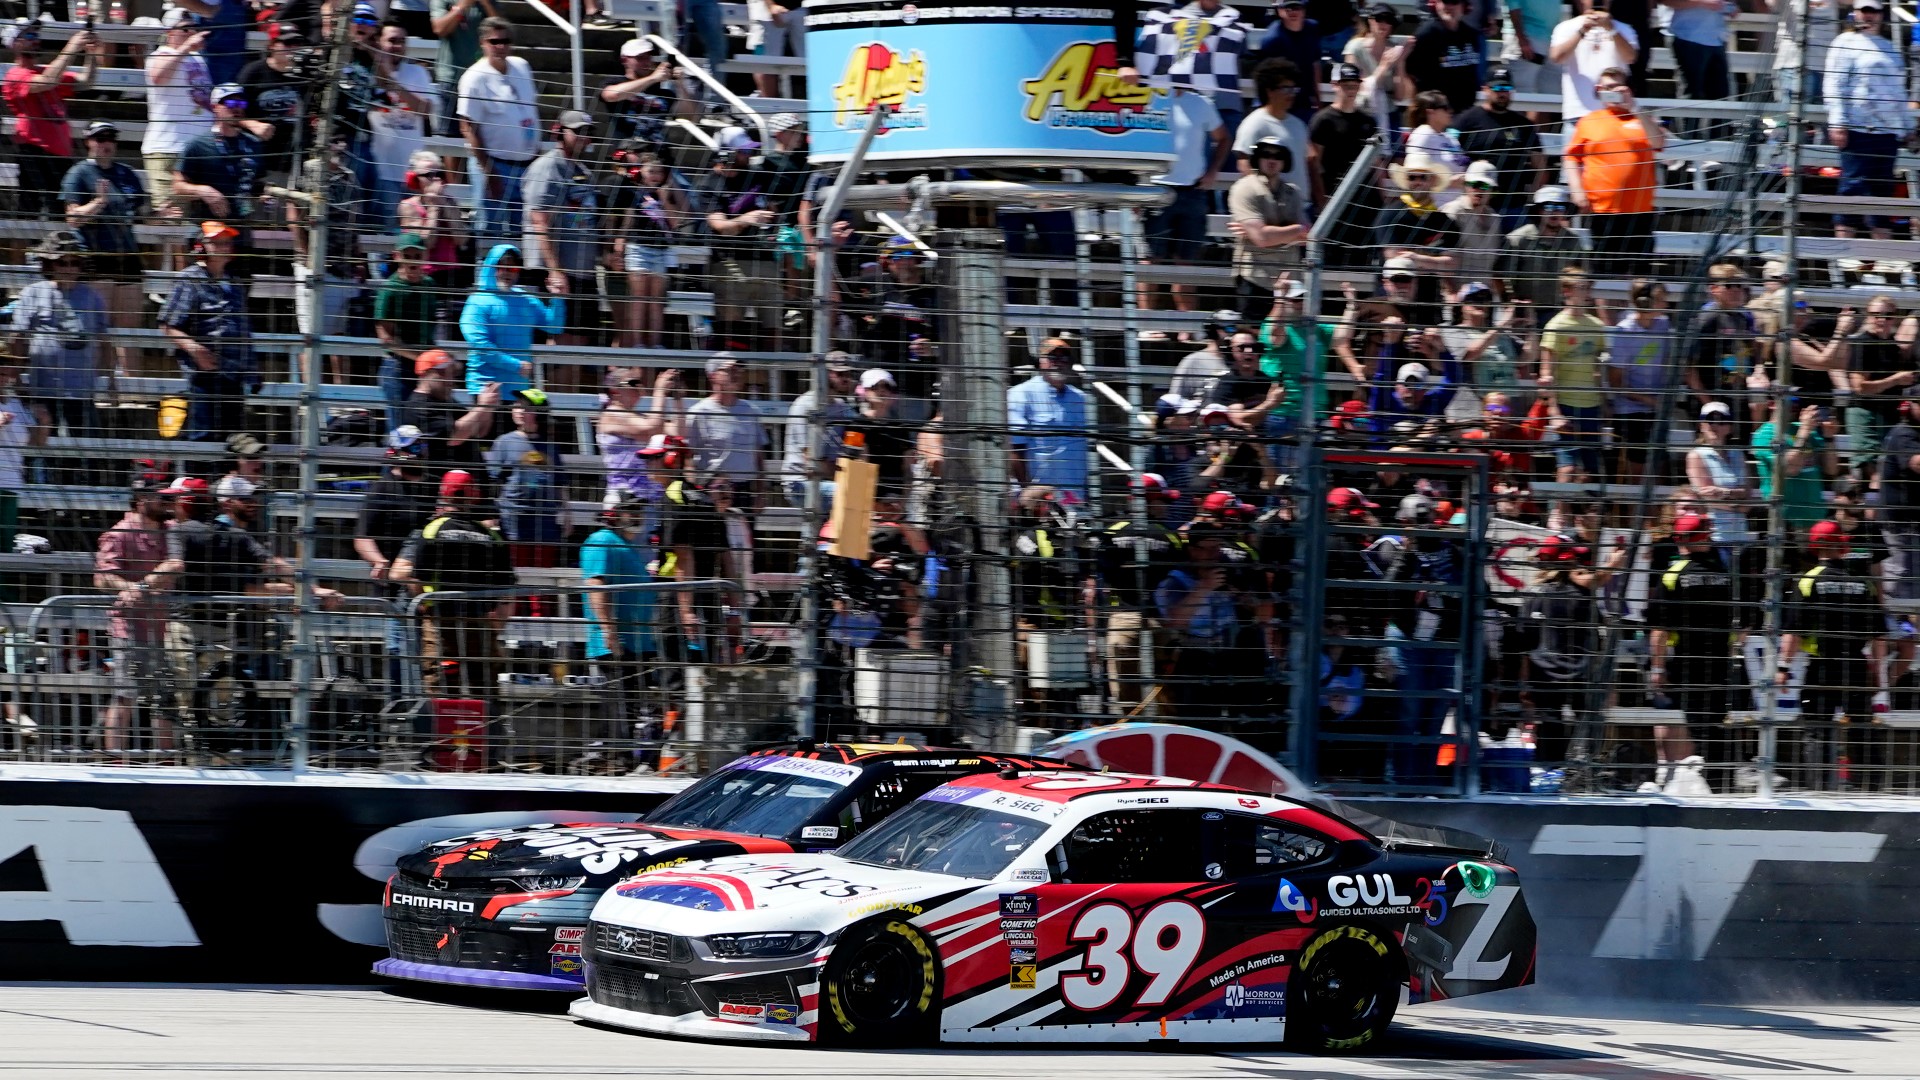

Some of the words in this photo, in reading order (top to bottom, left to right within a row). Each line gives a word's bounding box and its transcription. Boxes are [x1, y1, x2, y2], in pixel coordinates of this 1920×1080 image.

[892, 759, 919, 767] sam
[919, 758, 957, 768] mayer
[1009, 799, 1044, 813] SIEG
[1327, 873, 1412, 907] GUL
[392, 893, 475, 913] CAMARO
[848, 898, 923, 919] GOODYEAR
[1005, 900, 1032, 912] xfinity
[1319, 906, 1351, 917] GUIDED
[1352, 905, 1405, 916] ULTRASONICS
[1001, 919, 1037, 928] COMETIC
[1060, 899, 1207, 1012] 39
[1209, 969, 1236, 988] Made
[1235, 965, 1246, 975] in
[1247, 953, 1285, 971] America
[1245, 990, 1284, 998] MORROW
[721, 1003, 764, 1016] ARP
